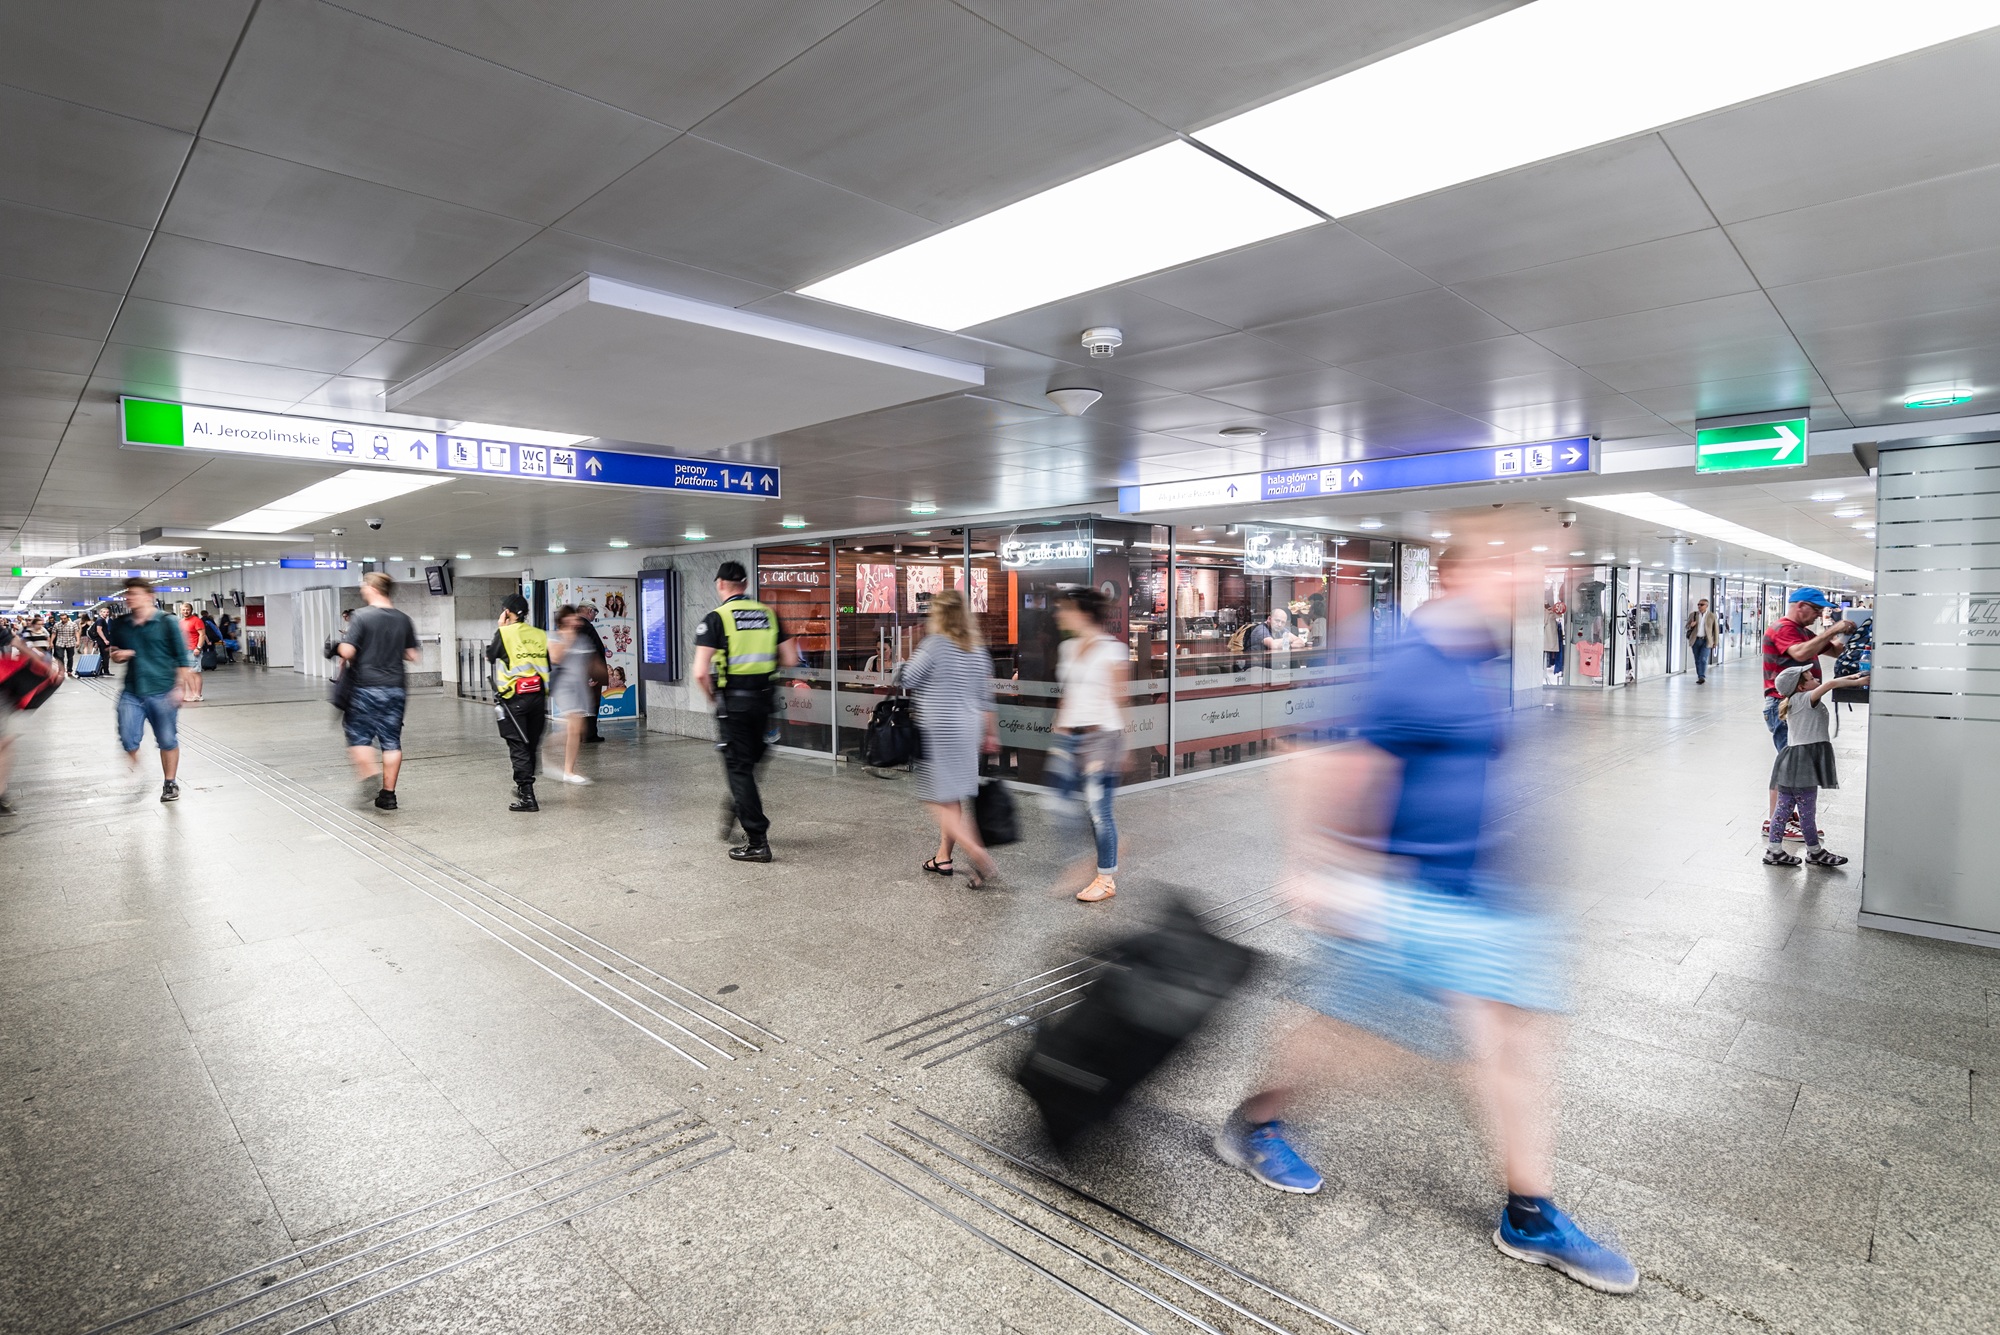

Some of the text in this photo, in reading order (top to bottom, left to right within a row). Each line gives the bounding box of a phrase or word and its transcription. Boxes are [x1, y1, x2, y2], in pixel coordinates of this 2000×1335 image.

[193, 422, 320, 445] Al. Jerozolimskie
[522, 449, 544, 462] WC
[522, 461, 534, 471] 24
[674, 464, 708, 477] perony
[674, 474, 718, 487] platforms
[720, 469, 754, 491] 1-4
[1267, 472, 1318, 485] hala główna
[1267, 483, 1306, 495] main hall
[1958, 629, 1985, 637] PKP
[845, 704, 865, 716] Coffee
[1201, 711, 1220, 724] Coffee
[1220, 710, 1226, 719] &
[998, 719, 1025, 733] Coffee
[1025, 721, 1033, 731] &
[1139, 718, 1154, 732] club
